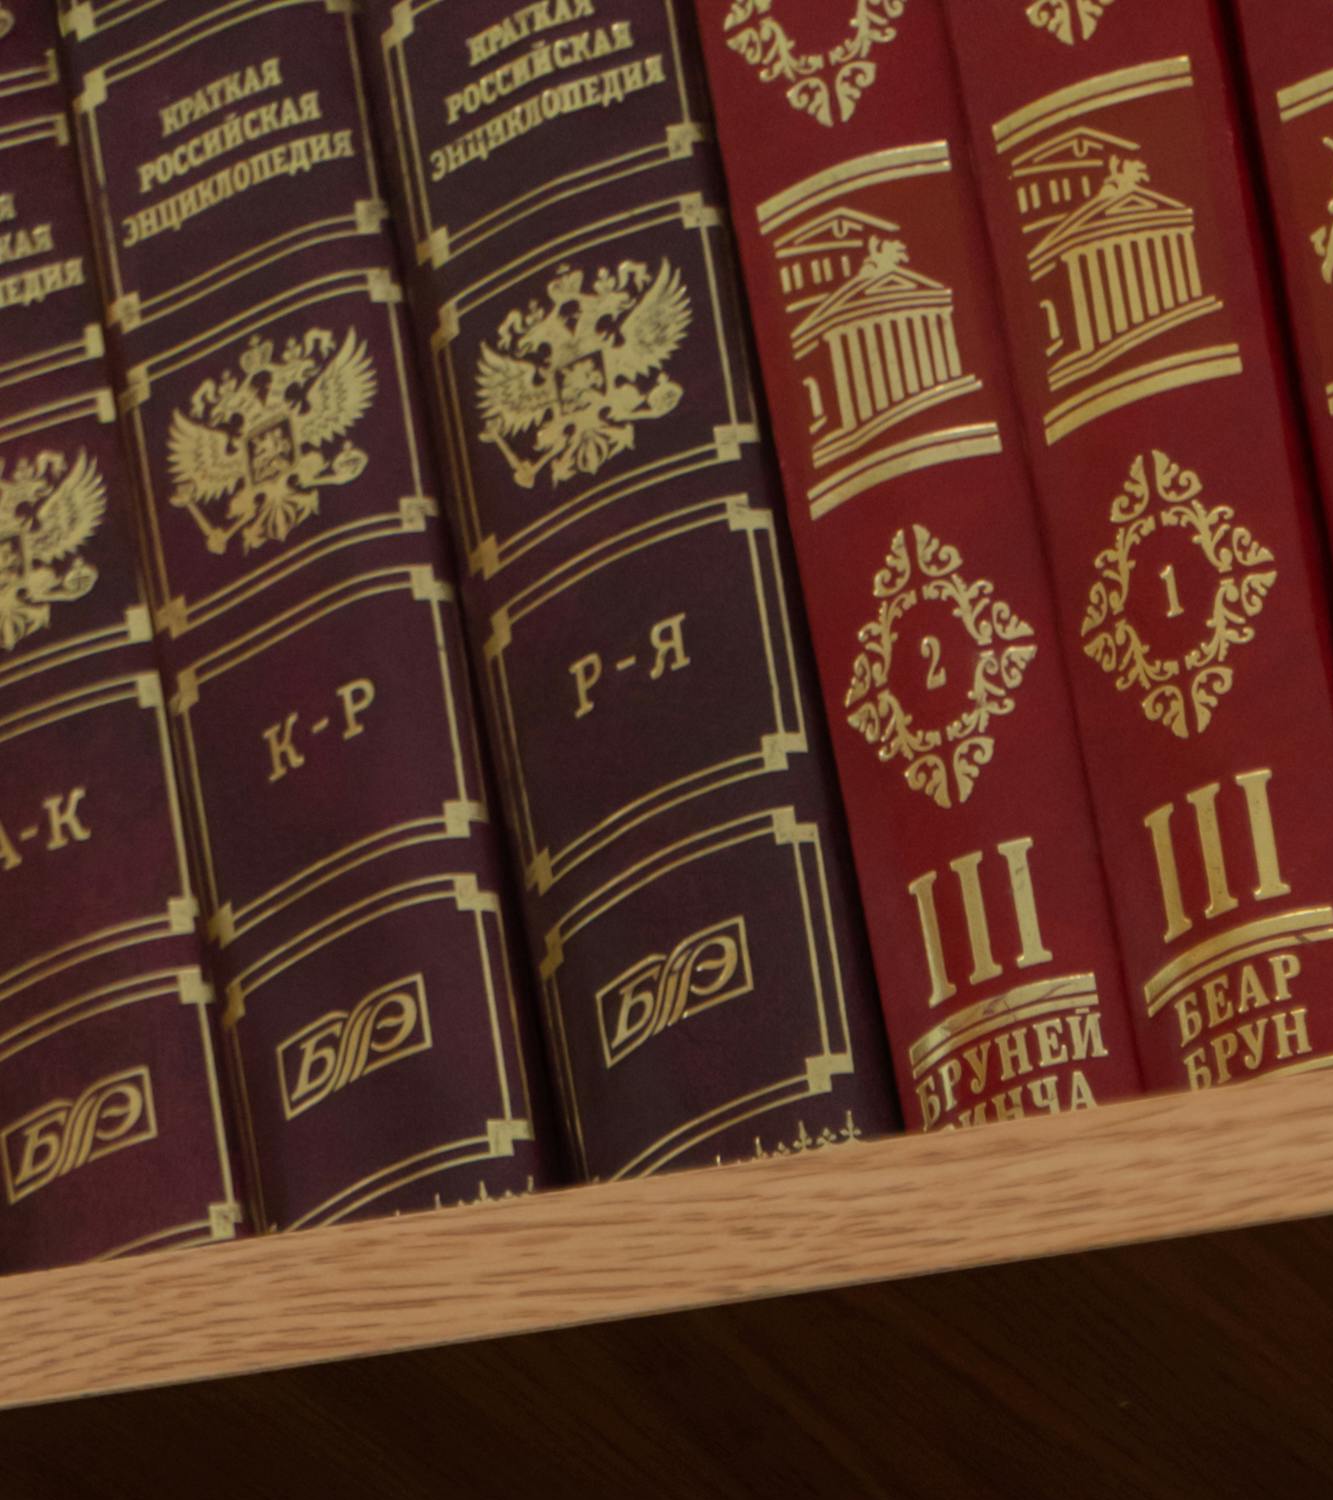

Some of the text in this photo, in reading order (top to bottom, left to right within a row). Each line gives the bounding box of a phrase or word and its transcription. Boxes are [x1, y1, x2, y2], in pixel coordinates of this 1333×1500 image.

[159, 56, 284, 138] КРАТКАЯ
[430, 54, 666, 182] ЭНЦИКЛОПЕДИЯ
[445, 20, 634, 125] РОССИЙСКАЯ
[121, 129, 354, 249] ЭНЦИКЛОПЕДИЯ
[138, 92, 323, 194] РОССИЙСКАЯ
[1159, 564, 1184, 619] 1
[920, 636, 947, 691] 2
[1144, 768, 1292, 945] III
[908, 836, 1053, 1009] III
[1174, 952, 1303, 1047] БЕАР
[1184, 1008, 1314, 1092] БРУН
[915, 1007, 1109, 1133] БРУНЕЙ
